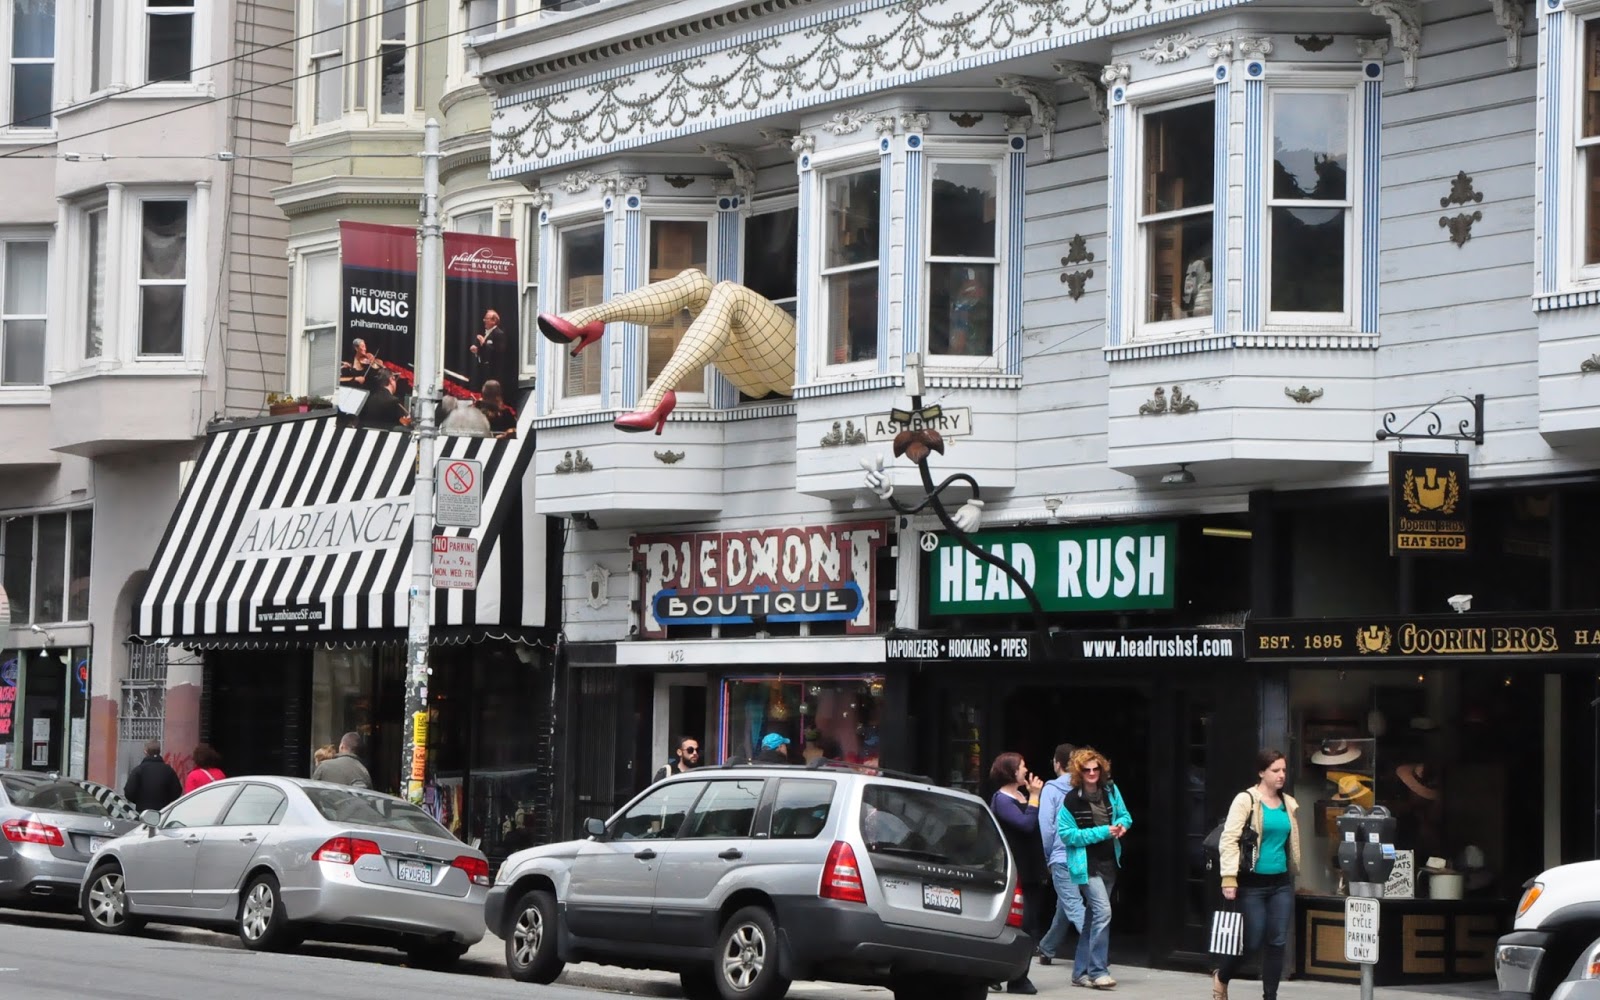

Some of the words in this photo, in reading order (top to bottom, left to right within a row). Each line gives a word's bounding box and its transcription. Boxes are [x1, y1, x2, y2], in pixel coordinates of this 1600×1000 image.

[471, 262, 509, 272] BAROQUE
[351, 286, 367, 296] THE
[370, 289, 397, 299] POWER
[398, 292, 408, 301] OF
[350, 296, 409, 318] MUSIC
[350, 319, 408, 334] philharmonia.org
[875, 414, 960, 435] ASHBURY
[236, 503, 410, 553] AMBIANCE
[435, 537, 447, 551] NO
[449, 541, 475, 553] PARKING
[1400, 536, 1427, 547] HAT
[1429, 537, 1463, 547] SHOP
[939, 542, 1036, 602] HEAD
[1057, 535, 1166, 599] RUSH
[637, 529, 880, 632] PIEDMONT
[668, 591, 848, 617] BOUTIQUE
[258, 608, 323, 622] www.ambianceSF.com
[1082, 634, 1233, 658] www.headrushsf.com
[1259, 636, 1295, 649] EST.
[1304, 635, 1343, 649] 1895
[1398, 623, 1486, 654] GOORIN
[667, 650, 685, 662] 1452
[887, 639, 939, 659] VAPORIZERS
[948, 638, 991, 658] HOOKAHS
[1001, 638, 1028, 658] PIPES
[917, 864, 974, 879] SUBARU
[1352, 917, 1372, 928] CYCLE
[1347, 931, 1376, 944] PARKING
[1353, 946, 1370, 958] ONLY
